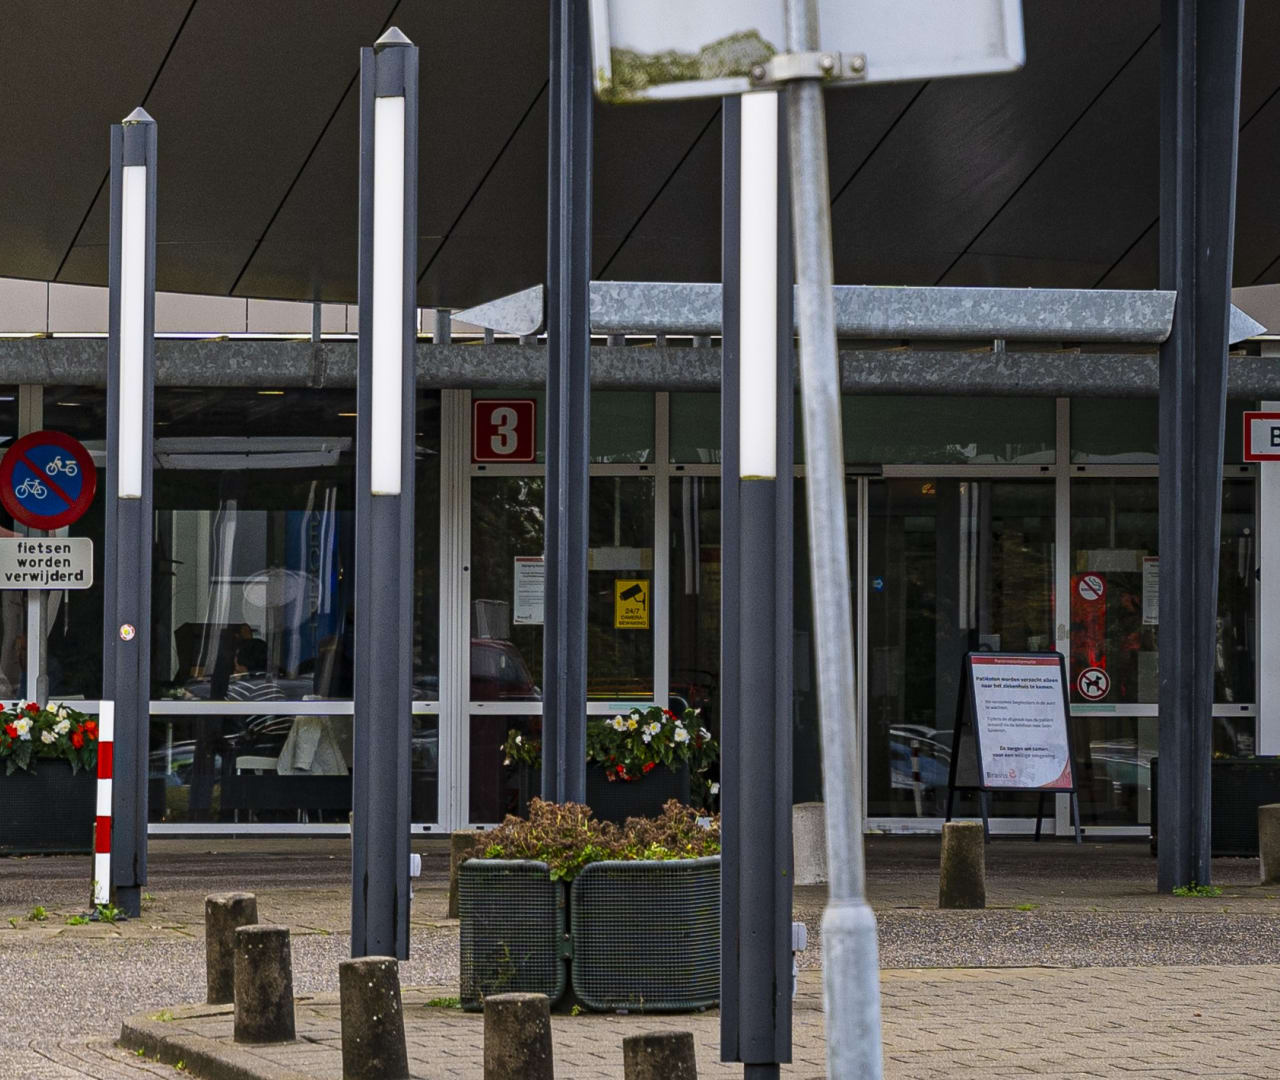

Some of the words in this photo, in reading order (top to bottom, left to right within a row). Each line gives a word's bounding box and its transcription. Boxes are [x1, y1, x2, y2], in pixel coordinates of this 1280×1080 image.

[490, 406, 518, 454] 3
[1270, 426, 1280, 447] B
[17, 541, 71, 554] fietsen
[17, 556, 71, 568] worden
[4, 569, 84, 585] verwijderd
